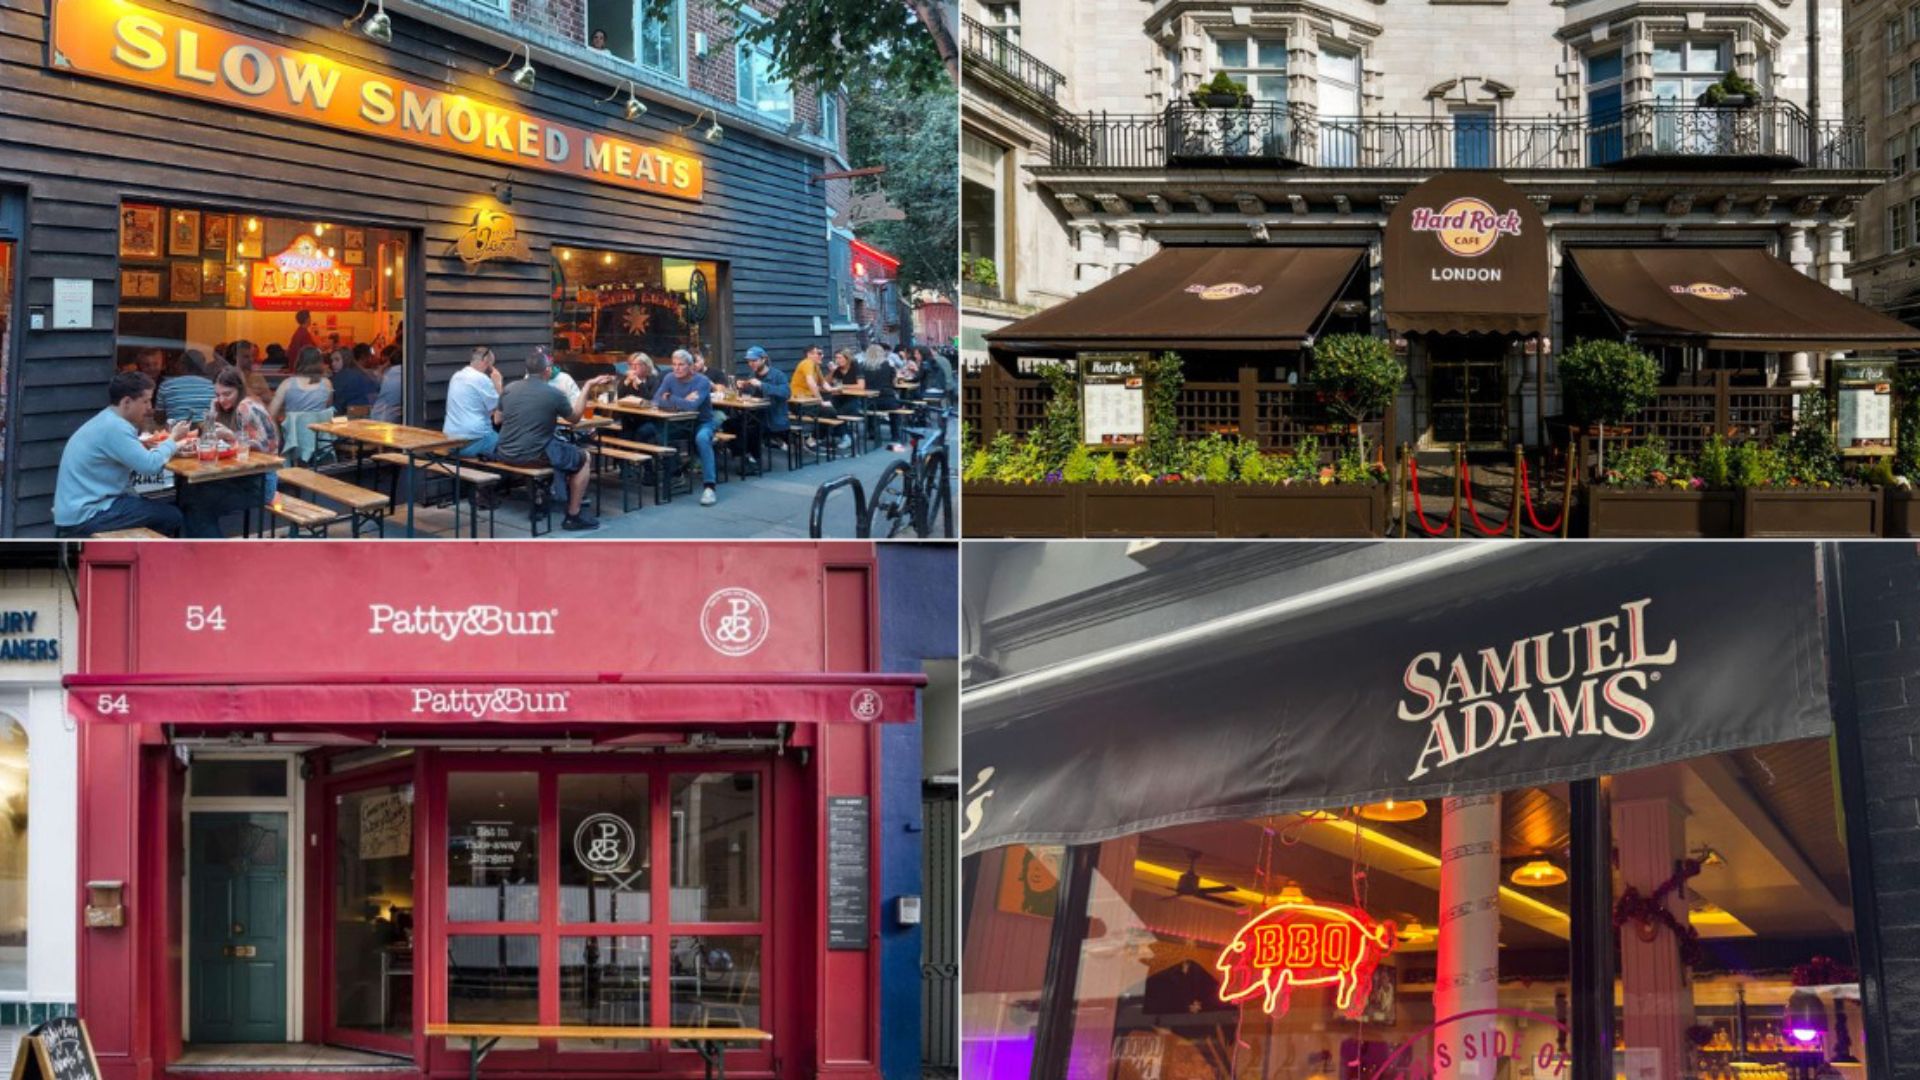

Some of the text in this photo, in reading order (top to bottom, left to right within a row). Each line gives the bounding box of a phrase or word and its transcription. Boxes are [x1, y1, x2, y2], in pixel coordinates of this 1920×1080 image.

[113, 15, 691, 190] SLOW SMOKED MEATS
[1412, 208, 1521, 235] Hard Rock
[1454, 236, 1480, 245] CAFE
[1431, 268, 1502, 281] LONDON
[186, 605, 226, 631] 54
[1398, 598, 1677, 721] SAMUEL
[97, 694, 130, 714] 54
[1253, 923, 1350, 972] BBQ
[1464, 1031, 1522, 1060] SIDE
